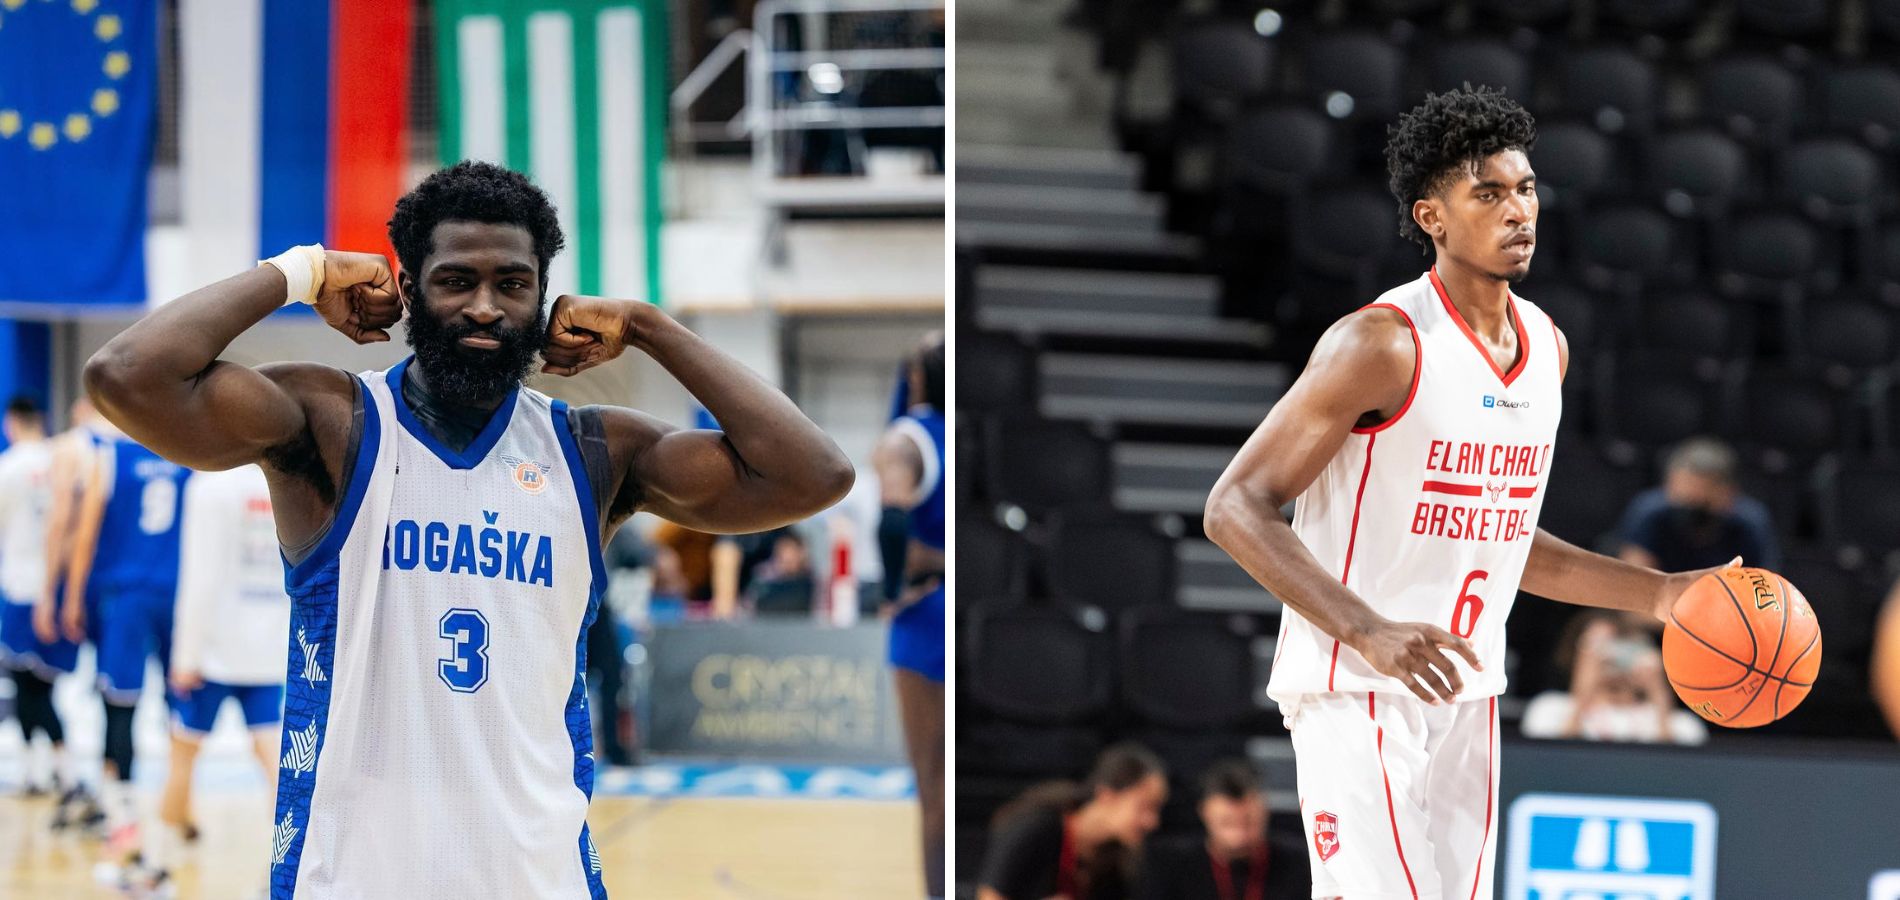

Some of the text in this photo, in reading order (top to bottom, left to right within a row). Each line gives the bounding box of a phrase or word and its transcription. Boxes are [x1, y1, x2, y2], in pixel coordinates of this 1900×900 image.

[522, 469, 538, 483] R
[1426, 440, 1486, 475] ELAN
[1411, 502, 1530, 542] BASKETB
[1450, 569, 1489, 639] 6
[438, 607, 490, 694] 3
